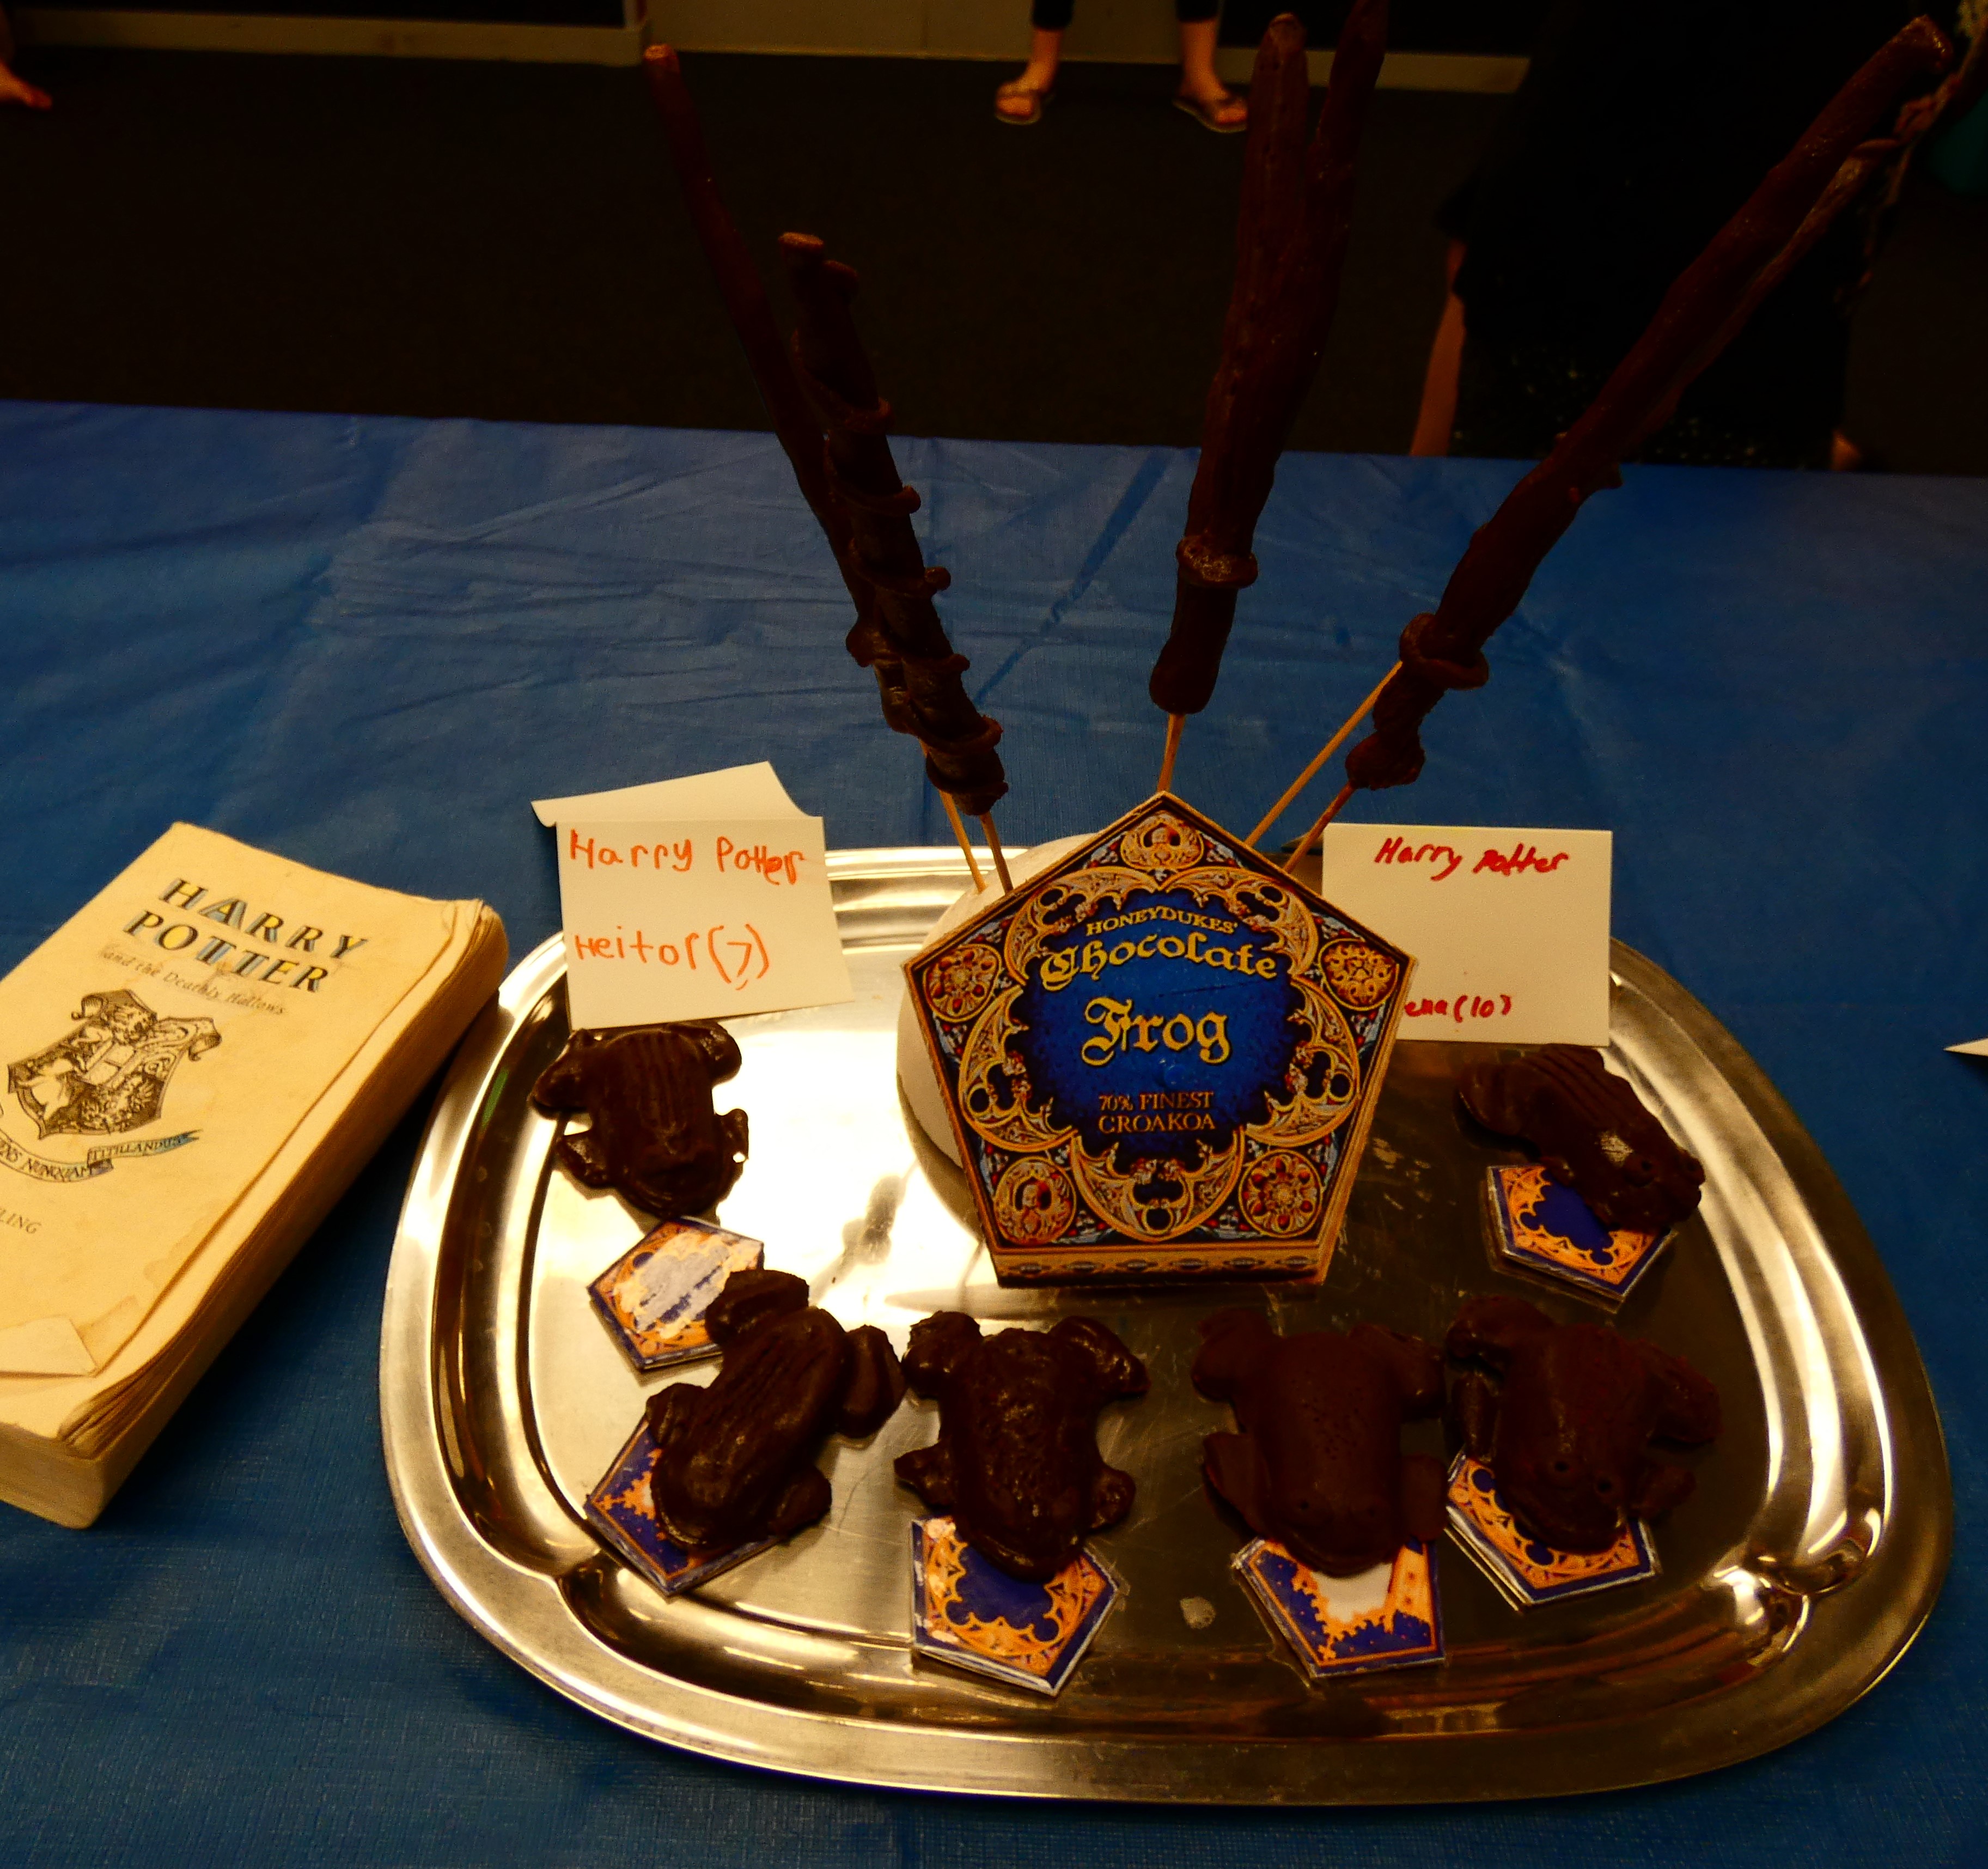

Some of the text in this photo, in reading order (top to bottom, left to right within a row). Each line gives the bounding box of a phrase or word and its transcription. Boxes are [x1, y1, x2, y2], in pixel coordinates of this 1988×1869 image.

[569, 829, 806, 886] Harry Potter
[1374, 836, 1463, 881] Harry
[158, 878, 368, 959] HARRY
[1086, 905, 1237, 936] HONEYDUKES'
[123, 910, 328, 993] POTTER
[1040, 932, 1278, 992] Chocolate
[101, 951, 284, 1015] and the Deathly Hallows
[1081, 996, 1231, 1066] Frog
[1098, 1091, 1214, 1111] 70% FINEST
[1098, 1112, 1216, 1134] CROAKOA
